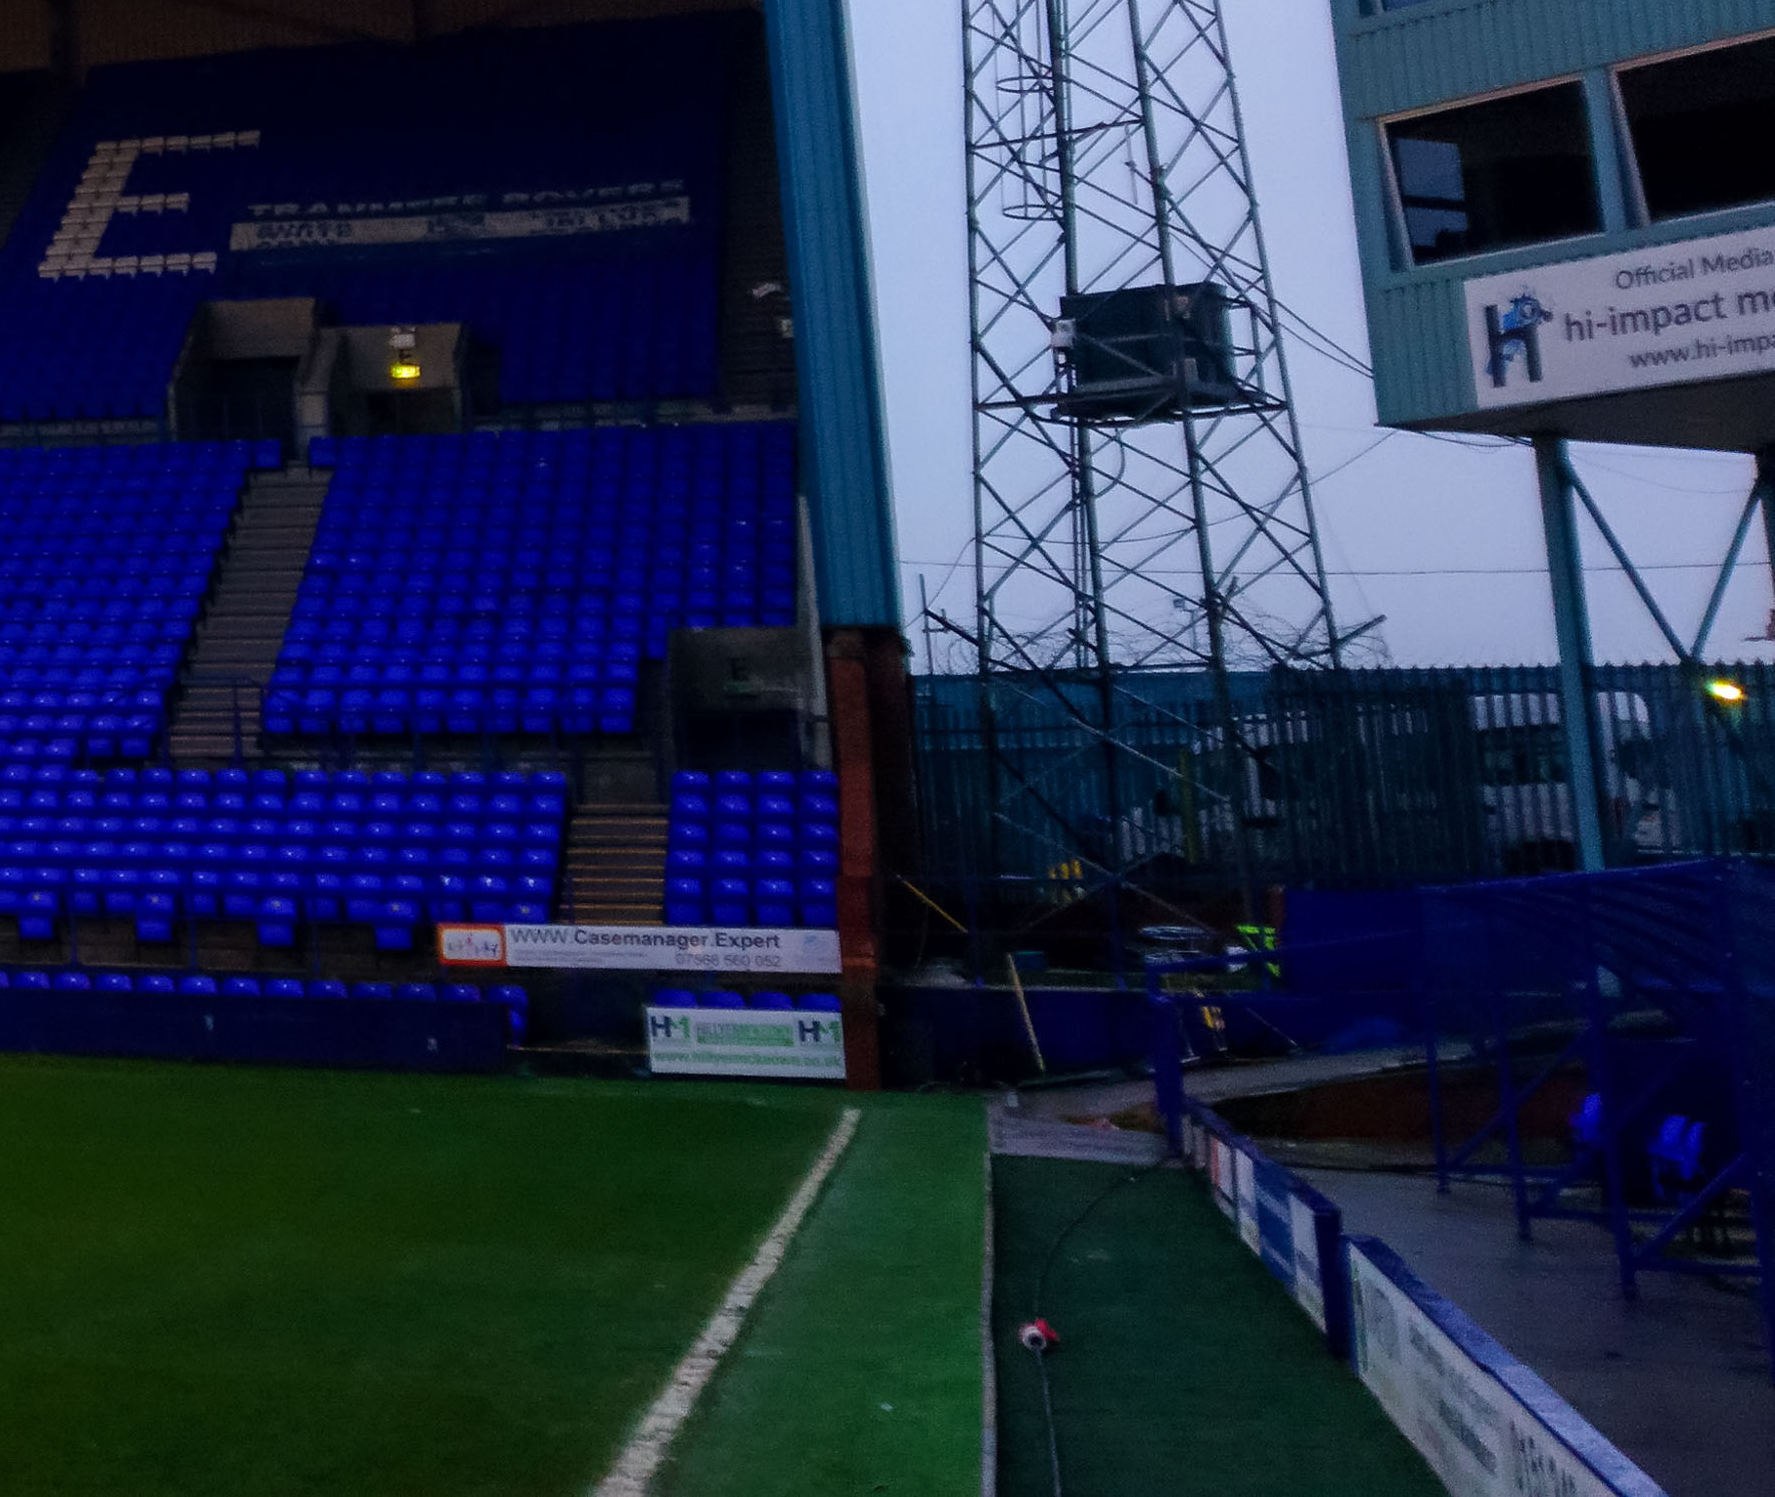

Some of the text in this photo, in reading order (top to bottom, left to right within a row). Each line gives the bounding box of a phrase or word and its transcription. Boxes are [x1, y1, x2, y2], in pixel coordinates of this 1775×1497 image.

[1615, 247, 1775, 290] Official Media
[1564, 292, 1728, 343] hi-impact
